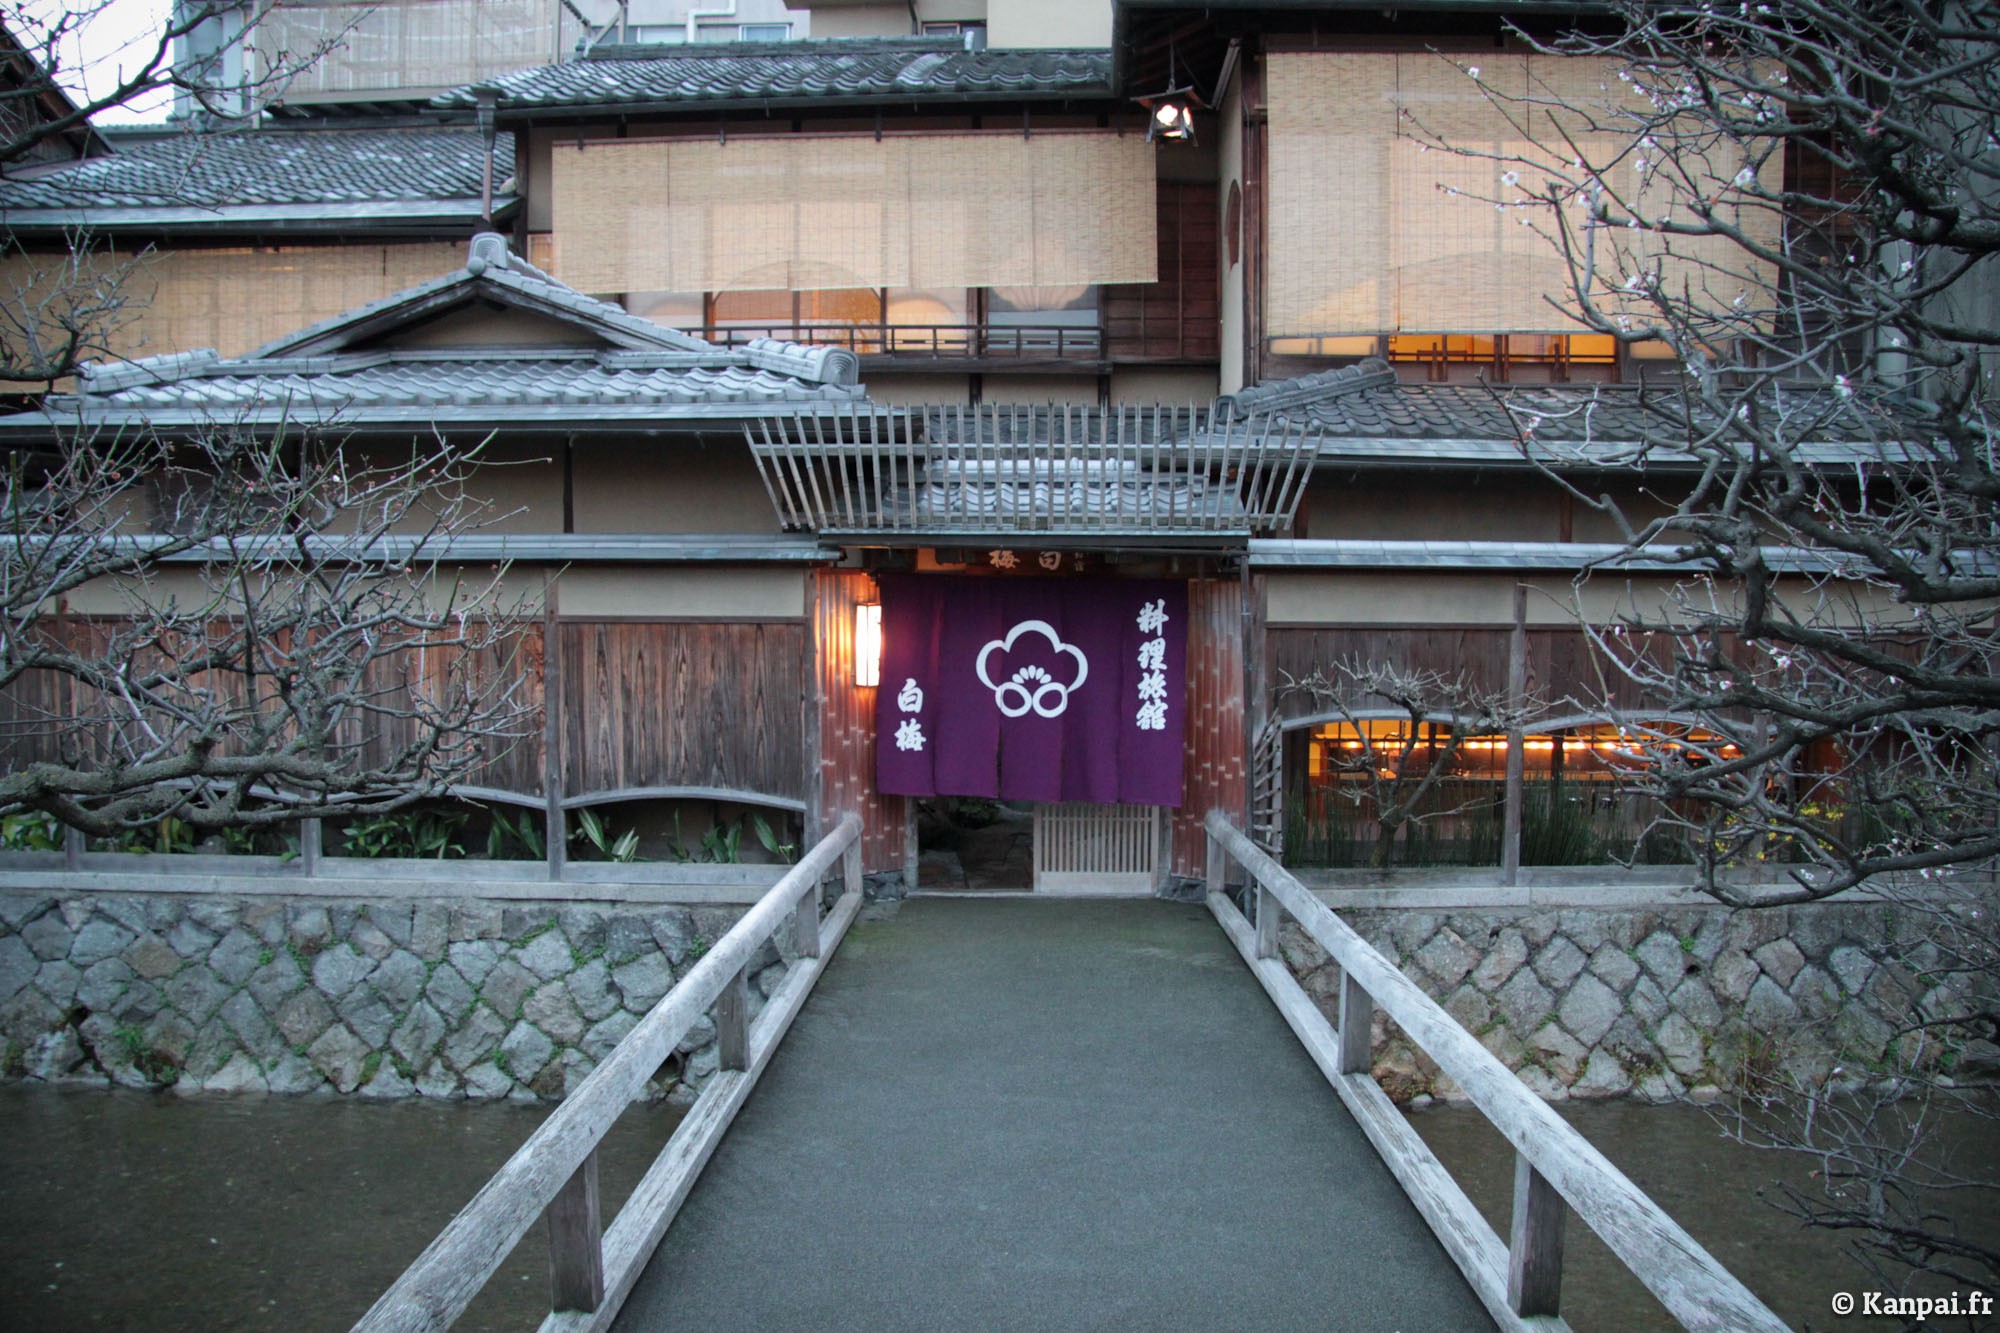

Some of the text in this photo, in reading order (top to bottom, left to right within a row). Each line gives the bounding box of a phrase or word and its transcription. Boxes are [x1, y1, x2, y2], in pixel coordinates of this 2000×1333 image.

[894, 678, 927, 752] 白梅
[1135, 598, 1170, 731] 料理旅館
